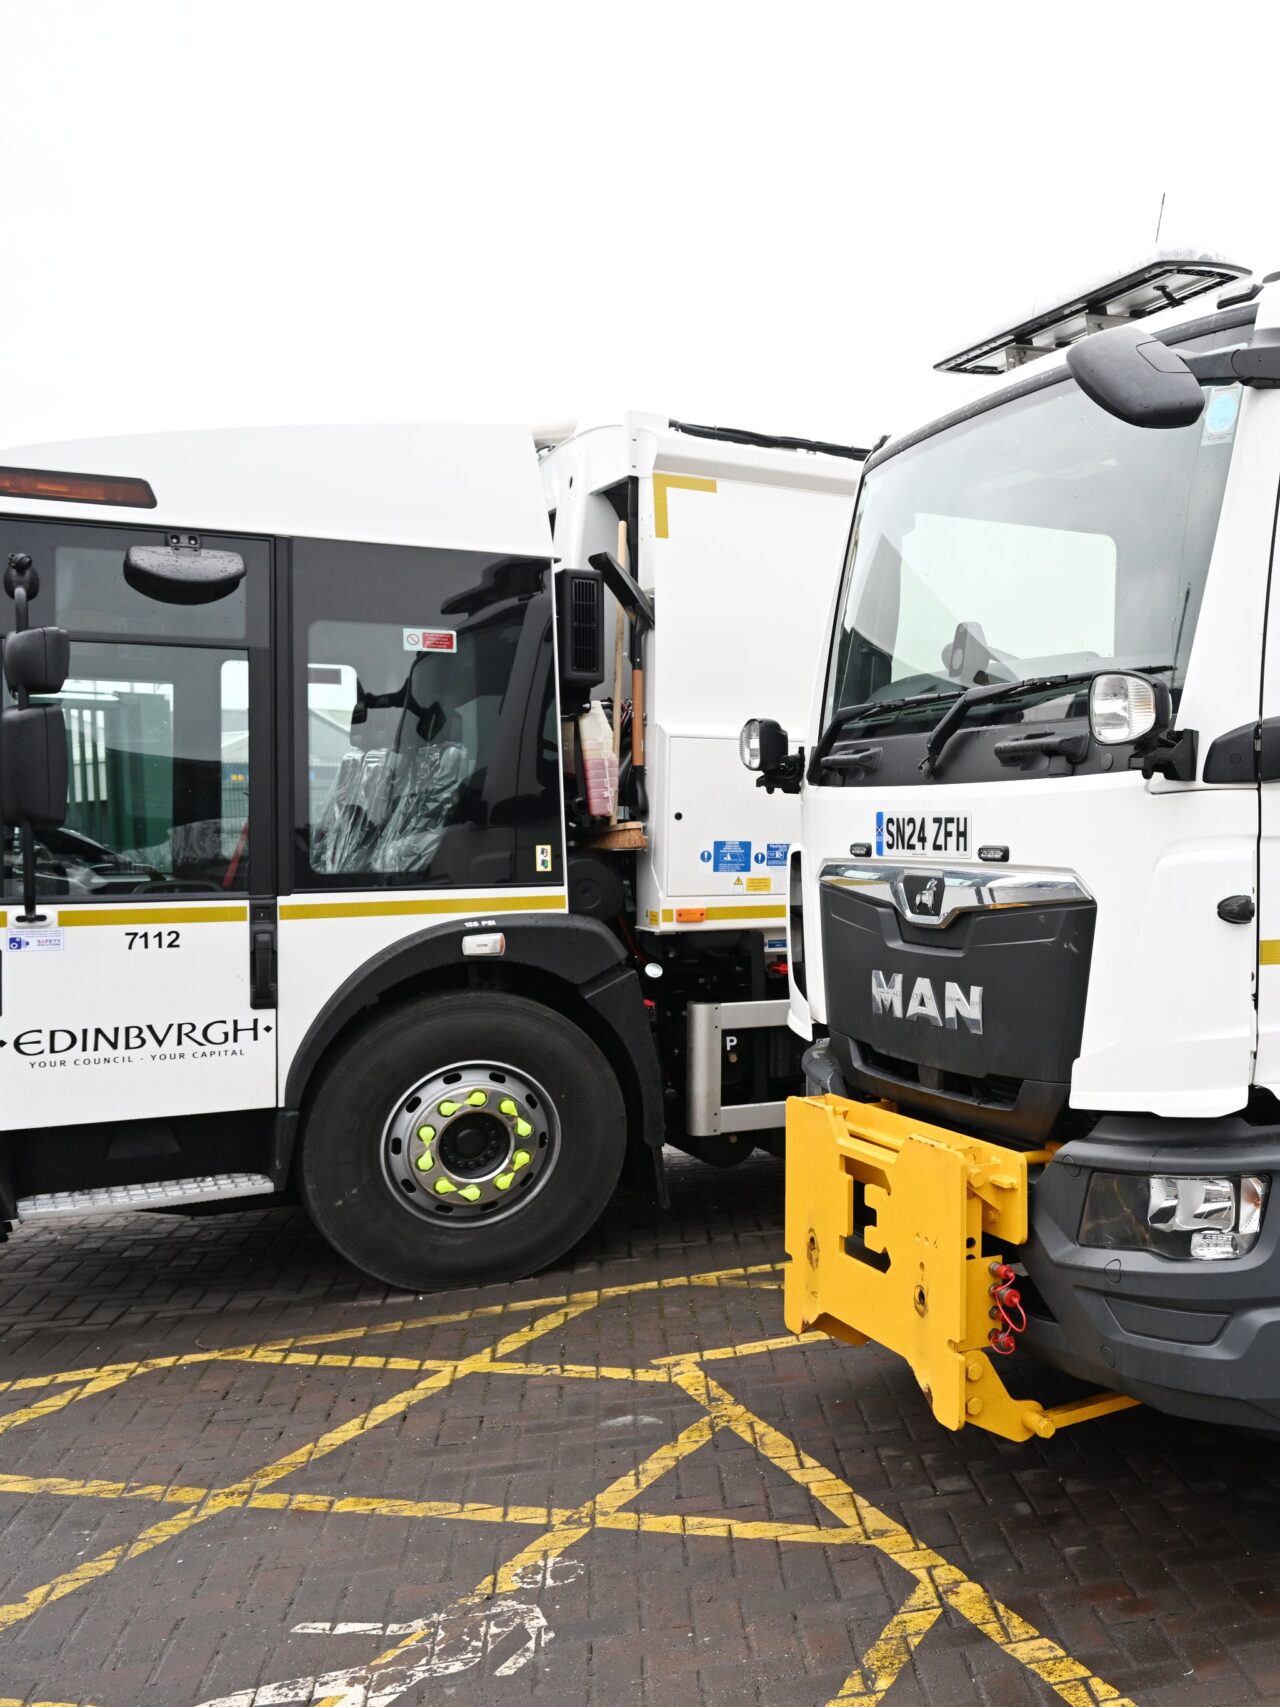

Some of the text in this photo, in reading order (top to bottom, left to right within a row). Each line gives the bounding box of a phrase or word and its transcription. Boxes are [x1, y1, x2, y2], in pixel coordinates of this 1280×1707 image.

[885, 816, 968, 852] SN24 ZFH
[125, 930, 181, 950] 7112
[872, 969, 983, 1035] MAN
[13, 1018, 259, 1056] EDINBVRGH
[725, 1036, 738, 1051] P
[29, 1059, 67, 1069] YOUR
[74, 1055, 133, 1066] COUNCIL
[150, 1051, 186, 1062] YOUR
[192, 1048, 246, 1059] CAPITAL
